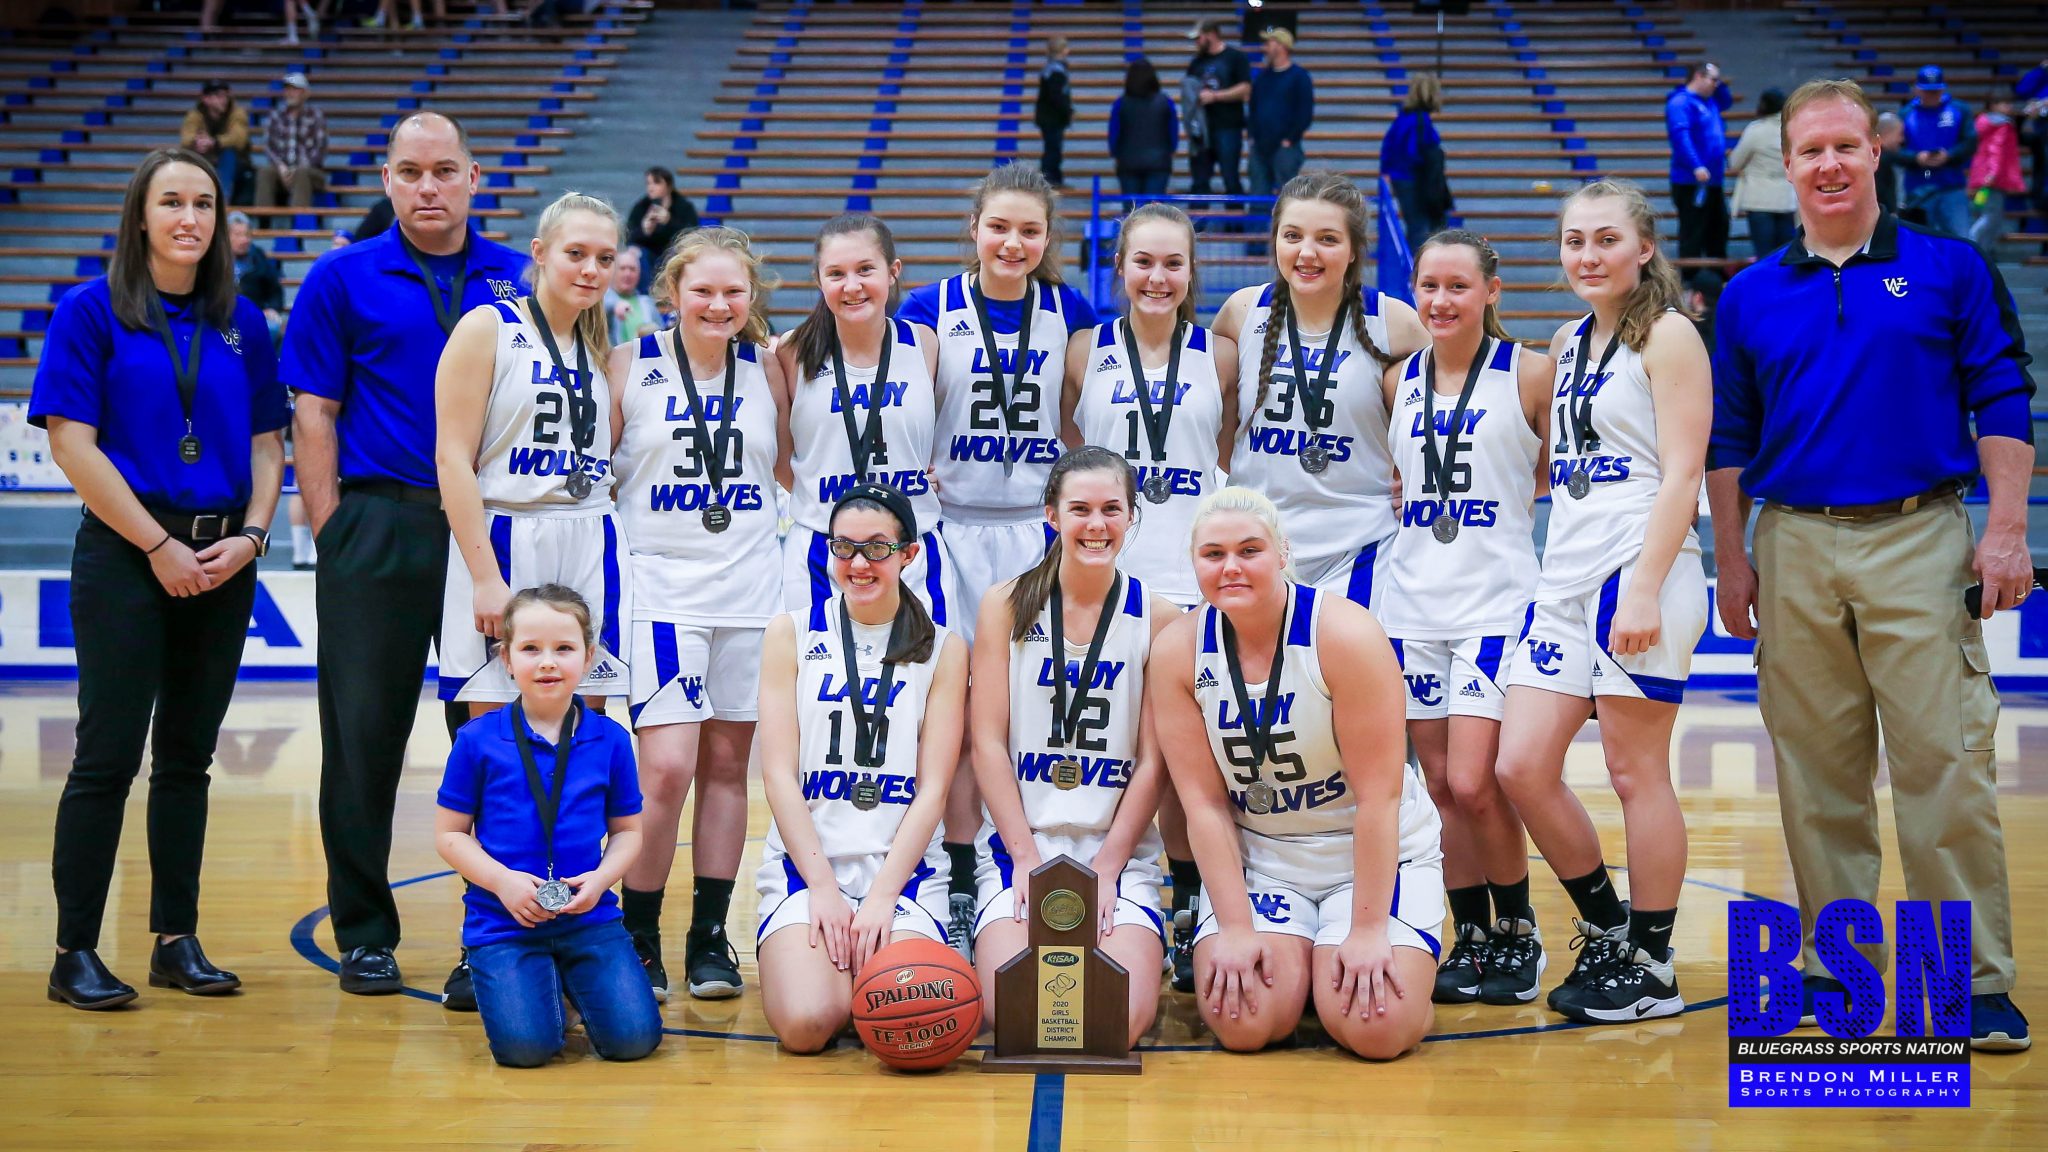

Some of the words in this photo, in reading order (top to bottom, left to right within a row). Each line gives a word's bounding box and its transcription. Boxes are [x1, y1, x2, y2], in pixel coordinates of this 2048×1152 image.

[971, 348, 1049, 375] LADY
[641, 378, 668, 386] adidas
[1556, 372, 1614, 398] LDY
[970, 381, 1040, 431] 22
[673, 428, 743, 478] 30
[950, 435, 1060, 464] WOLVES
[651, 484, 762, 511] WOLVES
[819, 469, 929, 503] WVES
[590, 671, 618, 679] adidas
[826, 710, 889, 768] 10
[1047, 696, 1110, 752] 12
[1018, 752, 1131, 788] WOVES
[1222, 731, 1307, 784] 55
[1230, 770, 1346, 814] WLVES
[865, 979, 955, 1013] SPALDING
[872, 1018, 957, 1043] TF-1000
